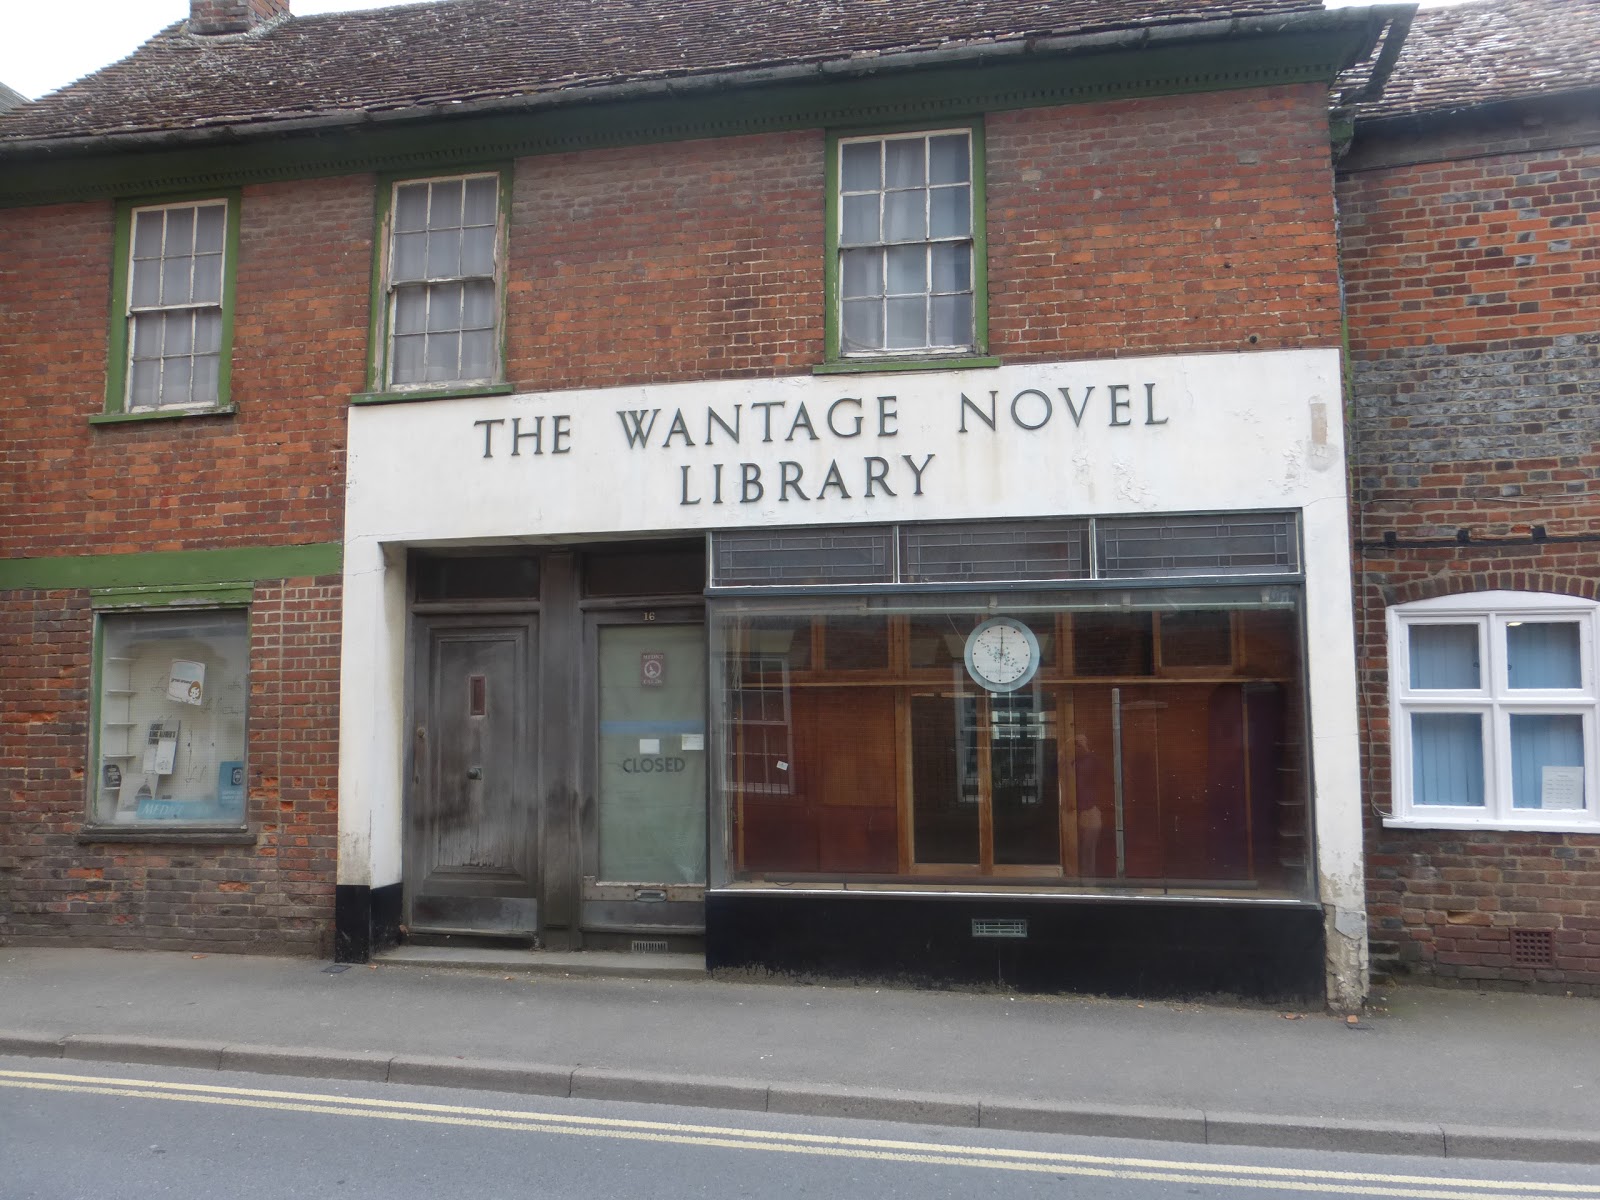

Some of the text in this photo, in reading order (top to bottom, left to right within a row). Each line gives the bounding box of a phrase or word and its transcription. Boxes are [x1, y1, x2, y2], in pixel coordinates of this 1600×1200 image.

[474, 383, 1169, 458] THE WANTAGE NOVEL
[679, 453, 936, 505] LIBRARY
[643, 611, 656, 621] 16
[622, 757, 686, 774] CLOSED
